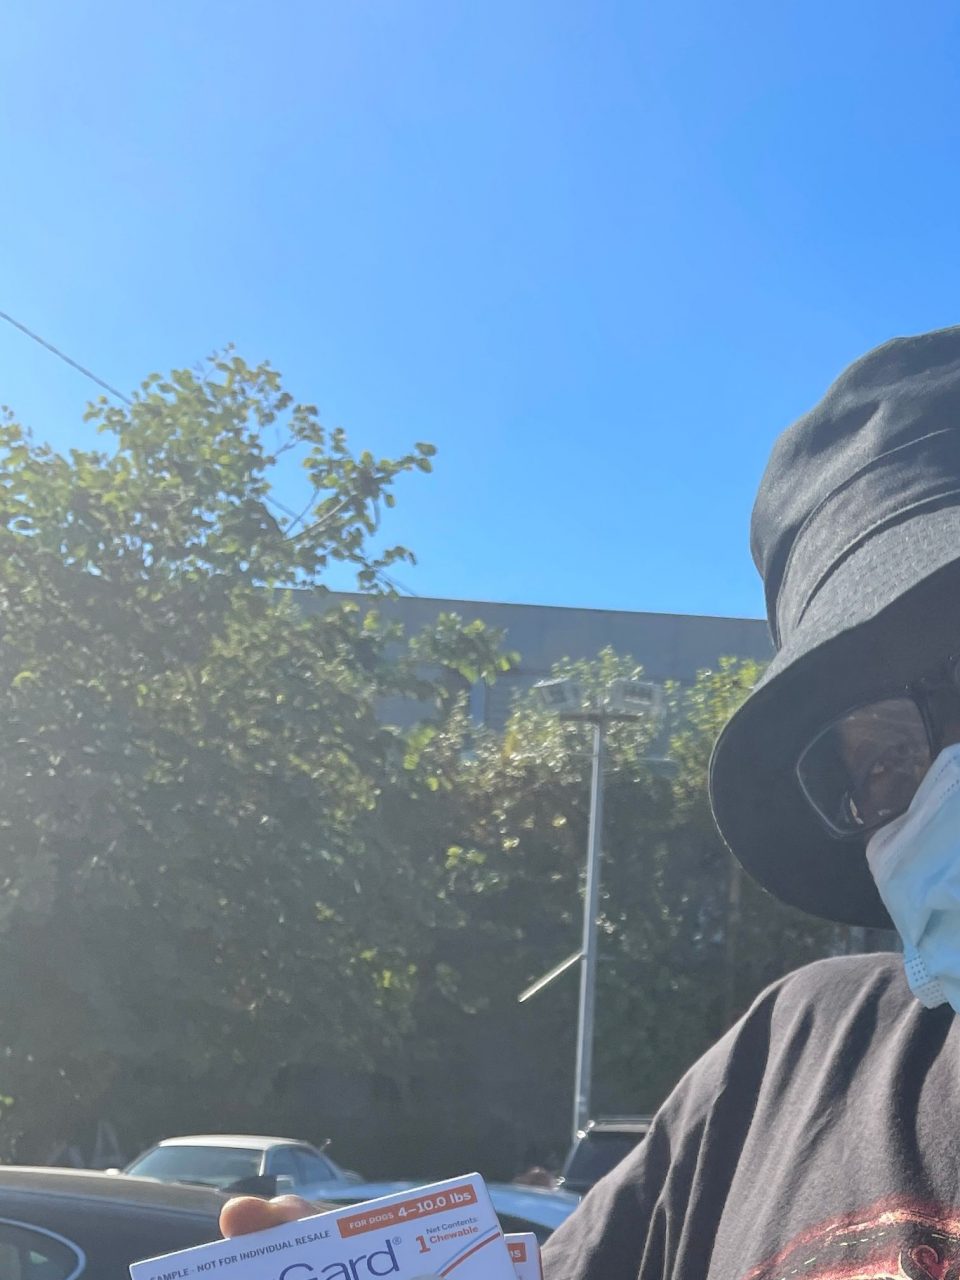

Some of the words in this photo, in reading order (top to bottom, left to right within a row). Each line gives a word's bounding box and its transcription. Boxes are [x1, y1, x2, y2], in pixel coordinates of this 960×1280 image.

[350, 1219, 367, 1230] FOR
[369, 1212, 394, 1225] DOGS
[449, 1192, 472, 1204] lbs
[416, 1235, 431, 1254] 1
[429, 1225, 479, 1244] Chewable
[426, 1224, 440, 1235] Net
[196, 1258, 217, 1273] NOT
[218, 1253, 238, 1266] FOR
[239, 1241, 294, 1262] INDIVIDUAL
[295, 1230, 331, 1246] RESALE
